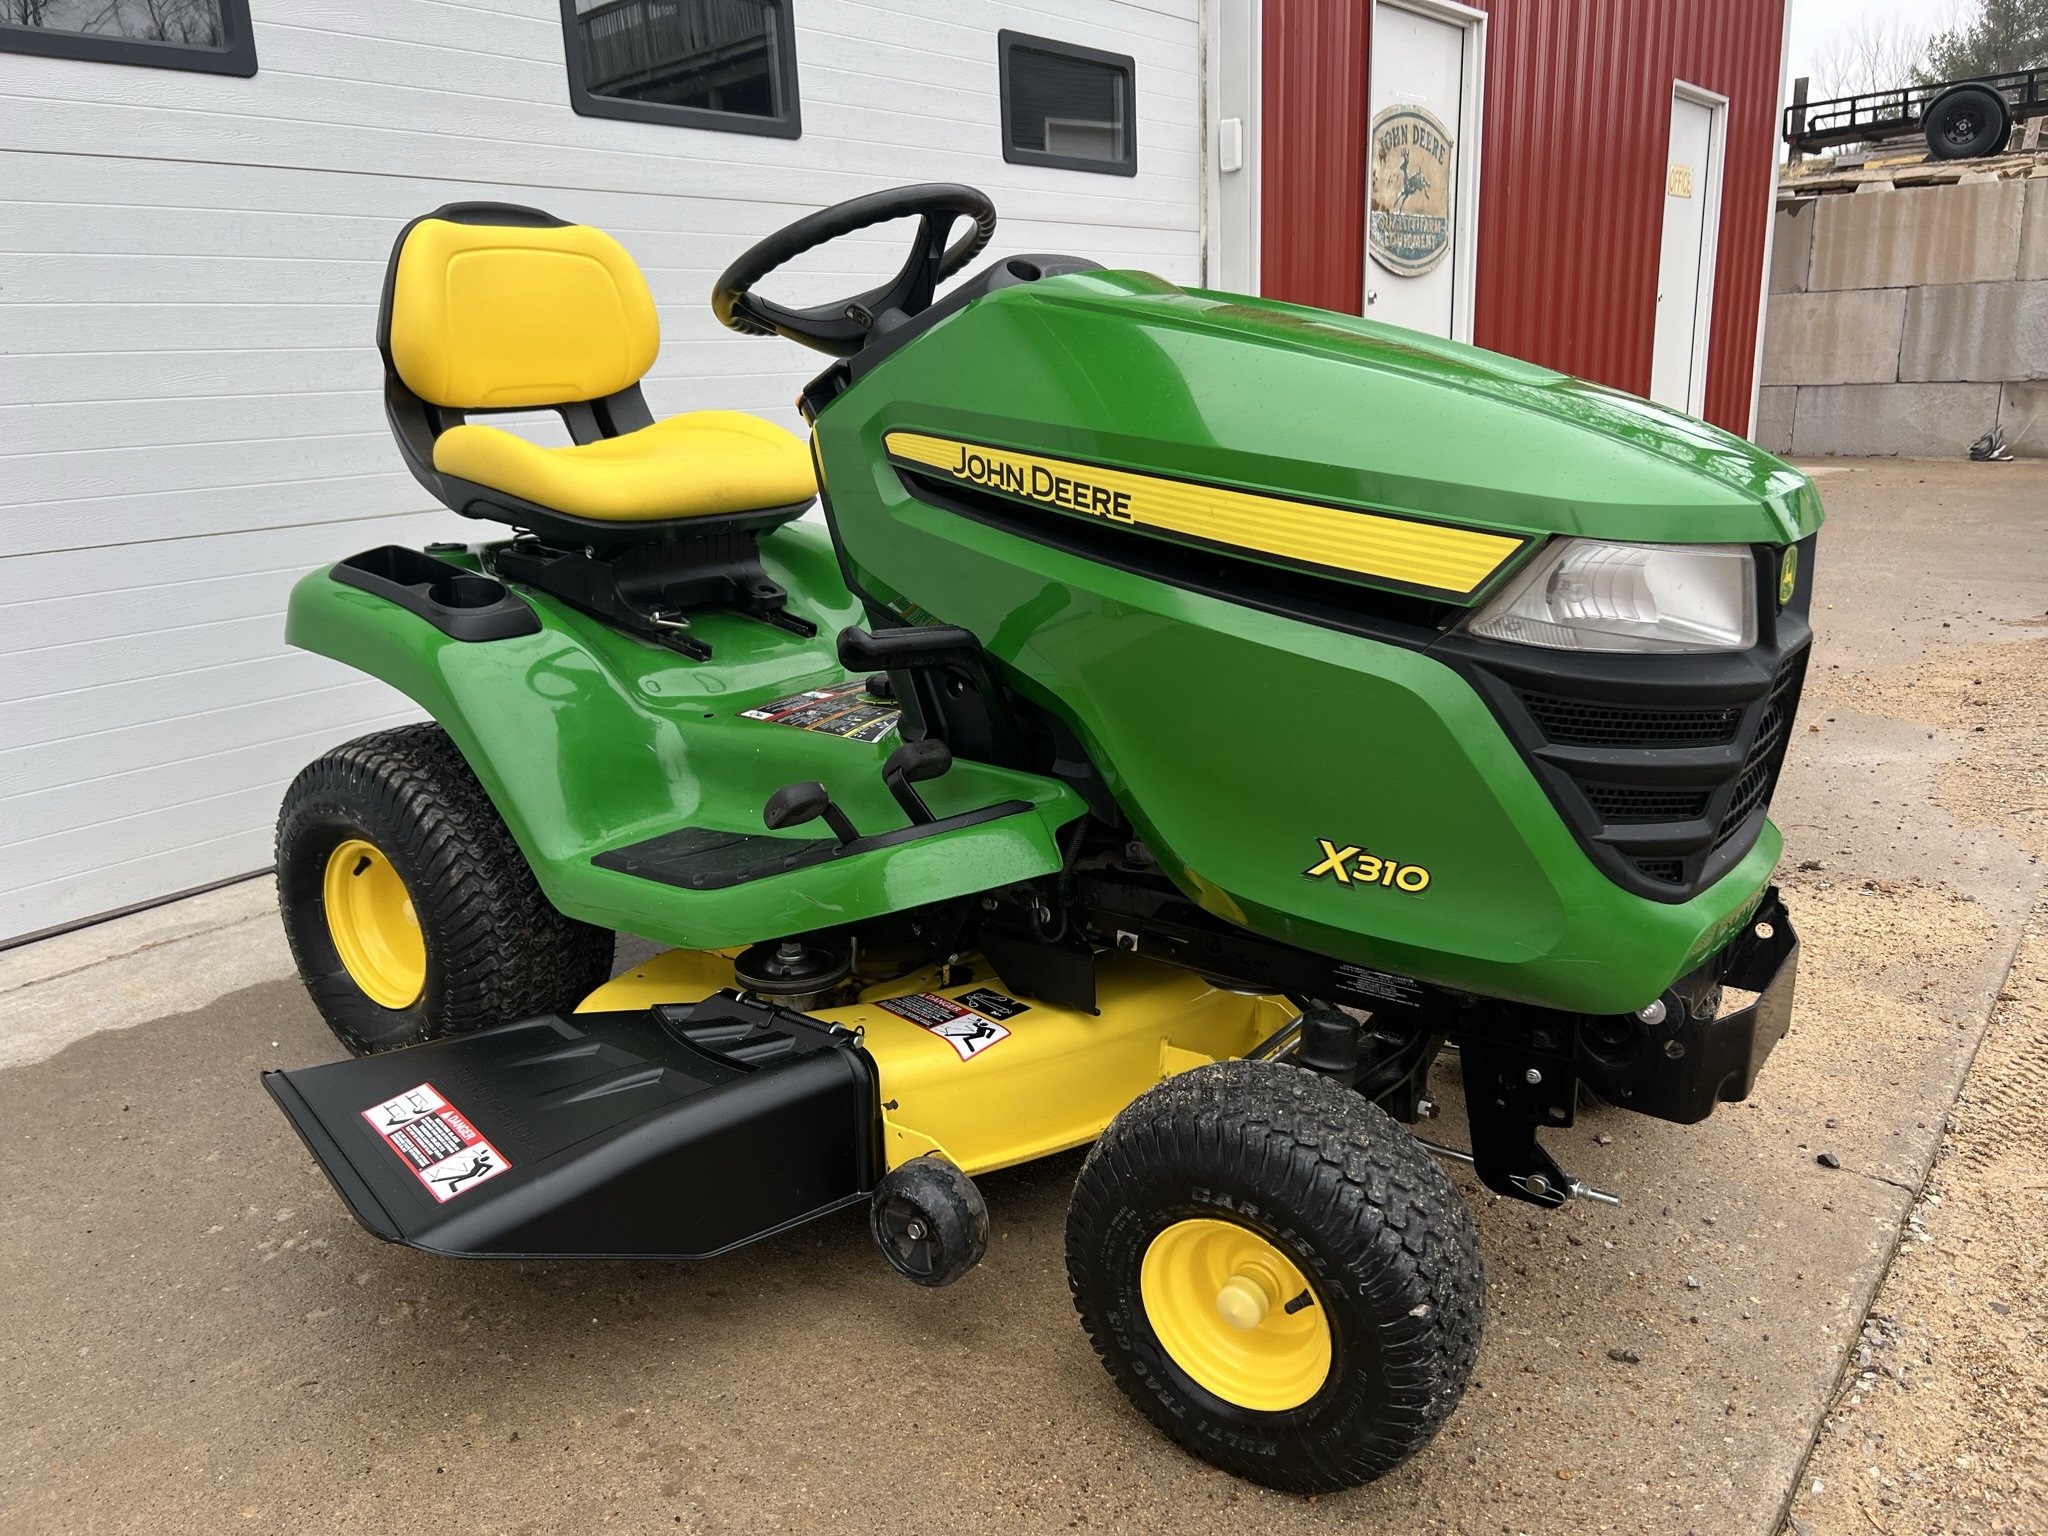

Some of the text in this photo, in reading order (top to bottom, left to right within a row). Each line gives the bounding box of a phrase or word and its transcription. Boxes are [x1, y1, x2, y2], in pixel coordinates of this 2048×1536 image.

[1378, 124, 1446, 165] JOHN DEERE
[1669, 170, 1691, 194] OFFICE
[952, 446, 1134, 523] JOHN DEERE
[1301, 837, 1432, 893] X310
[925, 994, 962, 1013] DANGER
[447, 1114, 476, 1140] DANGER
[1191, 1186, 1350, 1300] CARLISLE
